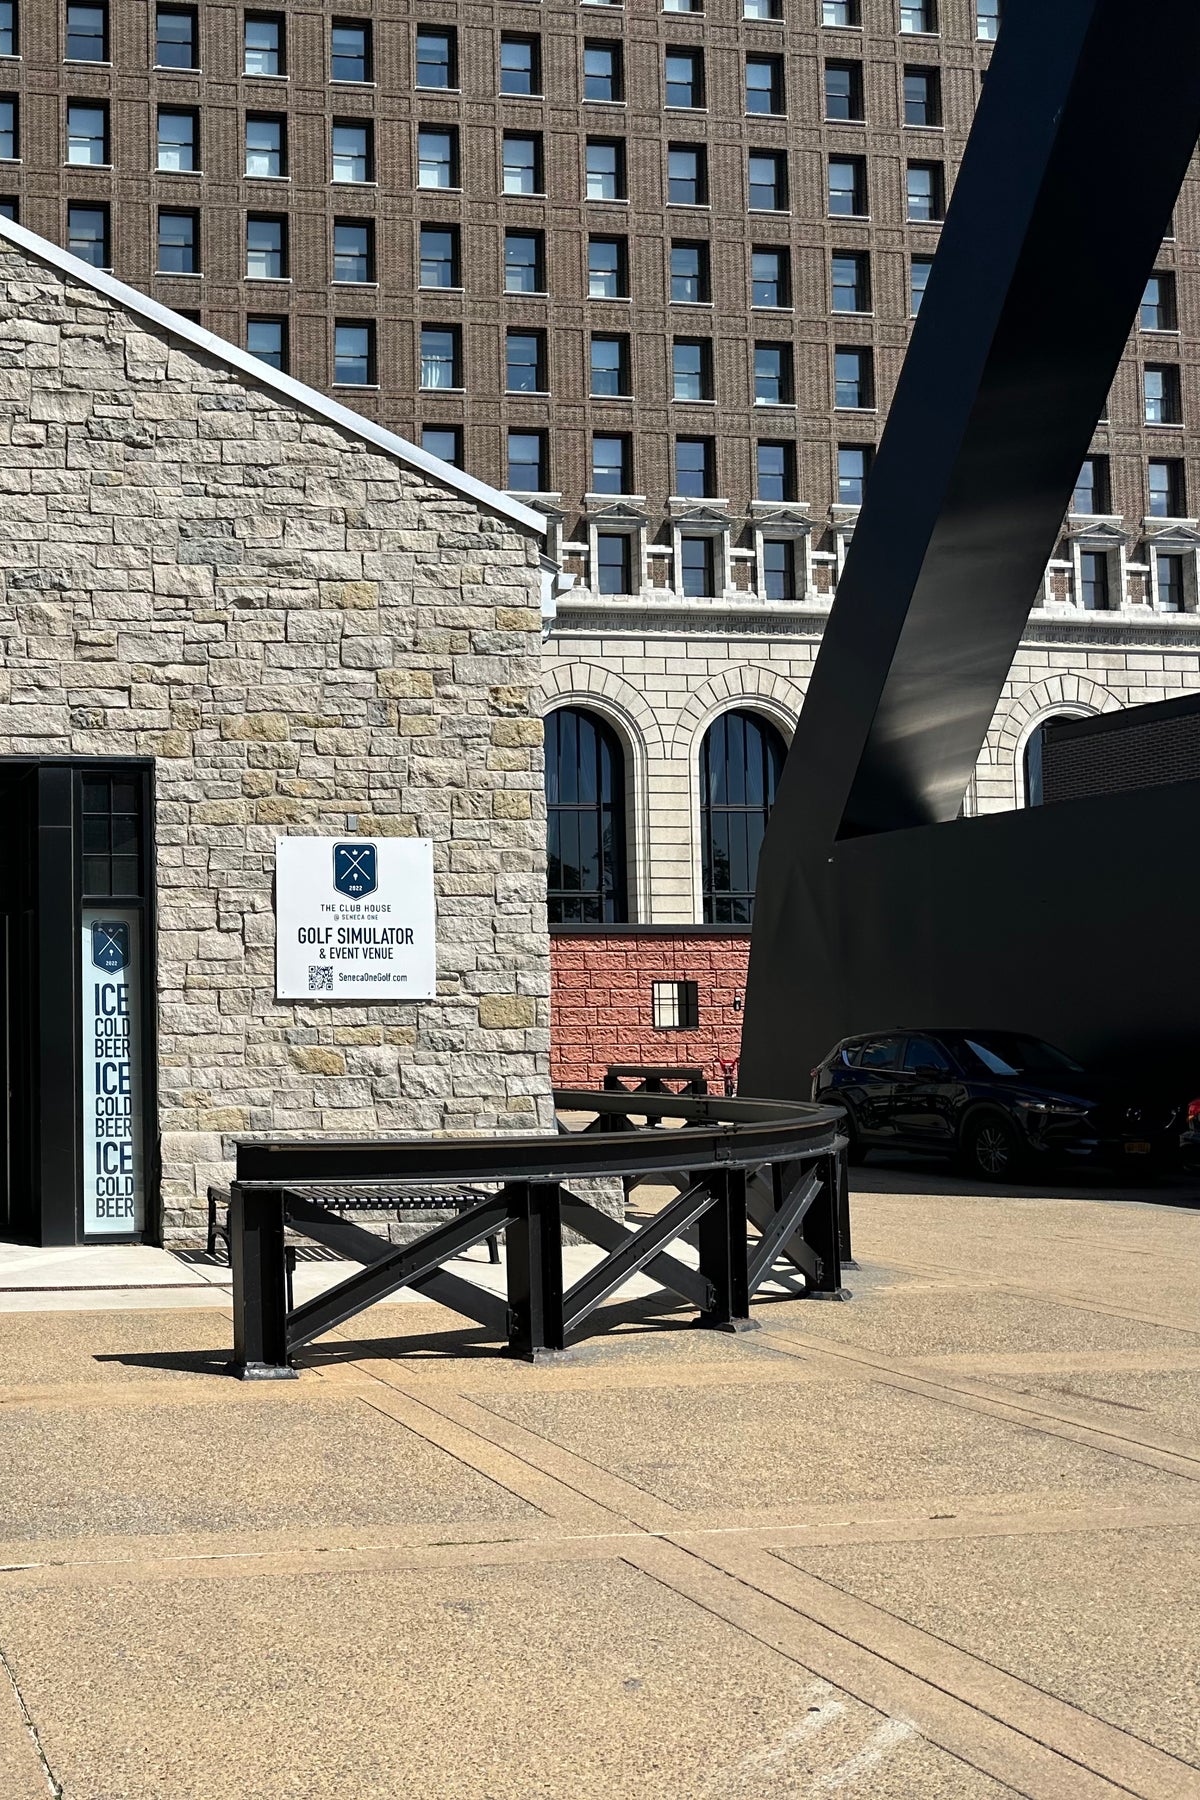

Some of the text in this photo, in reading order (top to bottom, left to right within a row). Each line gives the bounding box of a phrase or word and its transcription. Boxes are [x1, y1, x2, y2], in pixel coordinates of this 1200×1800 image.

[321, 904, 391, 912] THE CLUB HOUSE
[298, 927, 414, 945] GOLF SIMULATOR
[319, 947, 394, 959] & EVENT VENUE
[338, 973, 408, 982] SenecaOneGolf.com
[95, 983, 130, 1016] ICE
[95, 1017, 130, 1037] COLD
[95, 1038, 131, 1058] BEER
[96, 1062, 131, 1095] ICE
[96, 1097, 132, 1116] COLD
[96, 1118, 132, 1137] BEER
[96, 1141, 133, 1175] ICE
[96, 1176, 134, 1196] COLD
[96, 1197, 134, 1218] BEER
